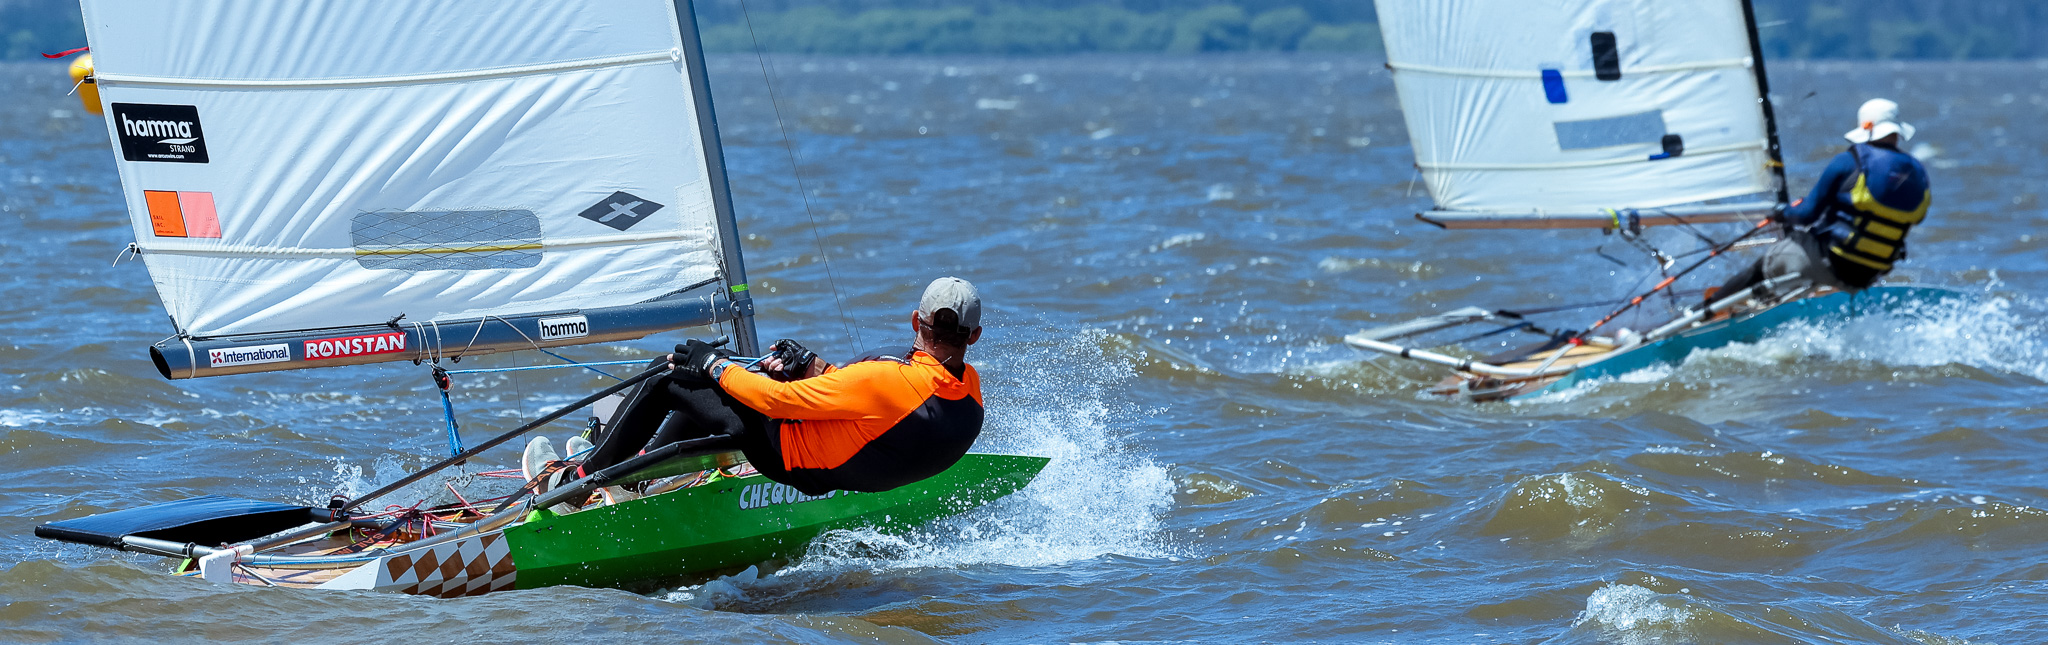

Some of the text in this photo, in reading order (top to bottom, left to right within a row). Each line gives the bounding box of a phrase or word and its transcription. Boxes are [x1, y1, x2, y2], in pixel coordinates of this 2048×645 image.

[121, 112, 193, 138] hamma
[169, 144, 196, 153] STRAND
[541, 321, 586, 337] hamma
[223, 346, 289, 363] International
[305, 334, 405, 358] RONSTAN
